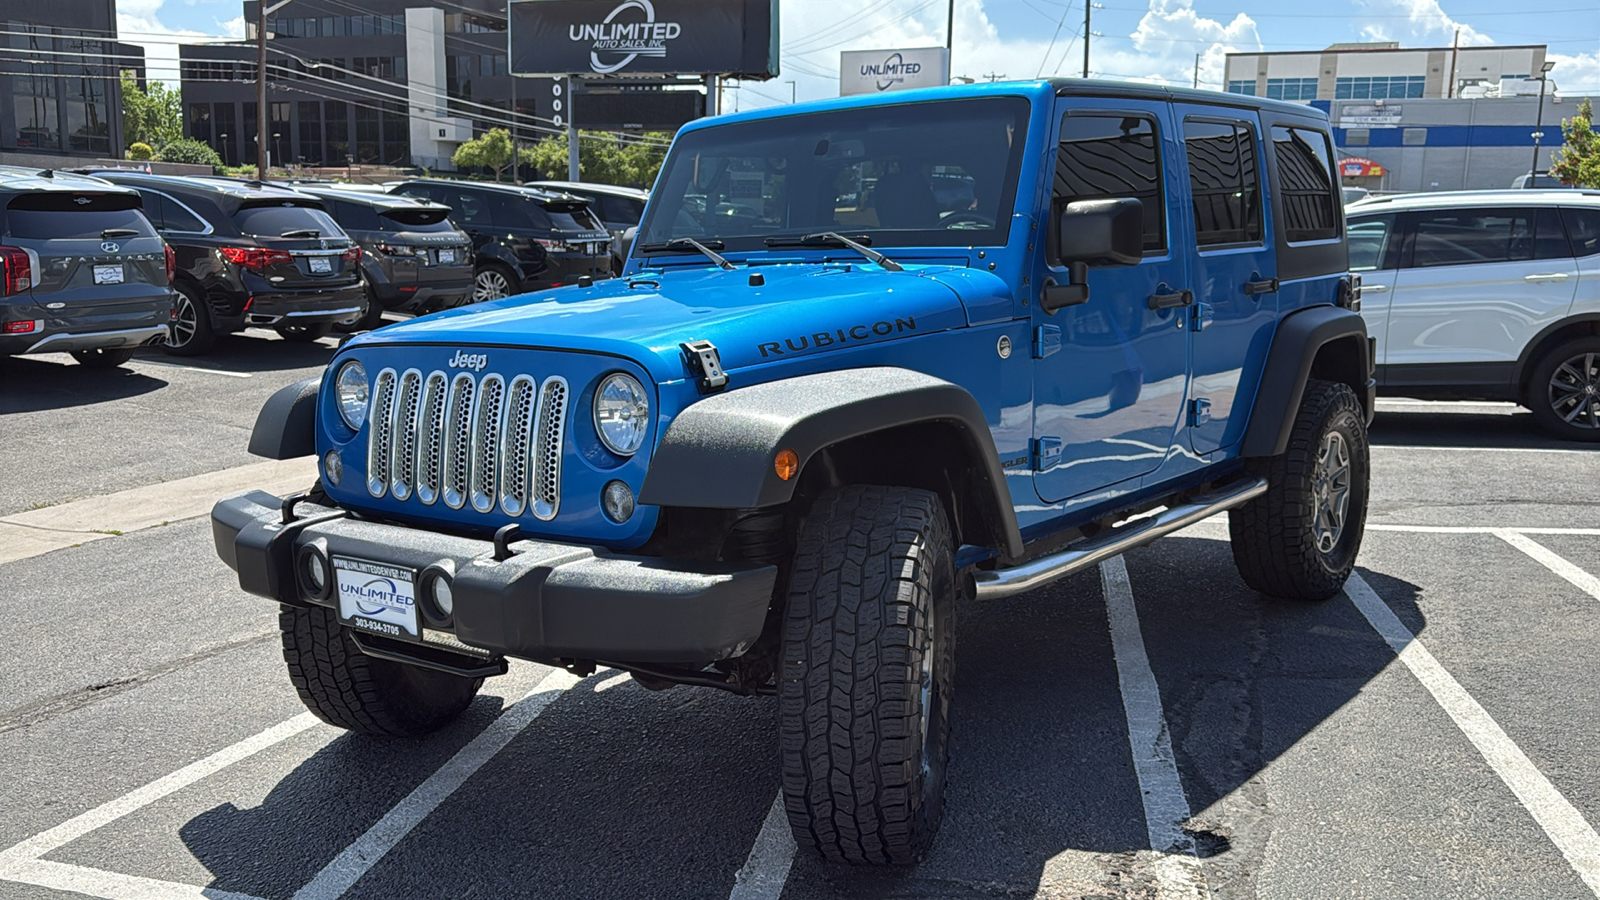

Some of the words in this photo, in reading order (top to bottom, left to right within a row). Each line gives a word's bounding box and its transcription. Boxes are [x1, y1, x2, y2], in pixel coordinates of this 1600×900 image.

[569, 22, 681, 41] UNLIMITED
[592, 40, 618, 48] AUTO
[860, 63, 921, 76] UNLIMITED
[757, 316, 916, 358] RUBICON
[448, 349, 487, 372] Jeep
[340, 583, 415, 606] UNLIMITED
[355, 617, 400, 636] 303-934-3705
